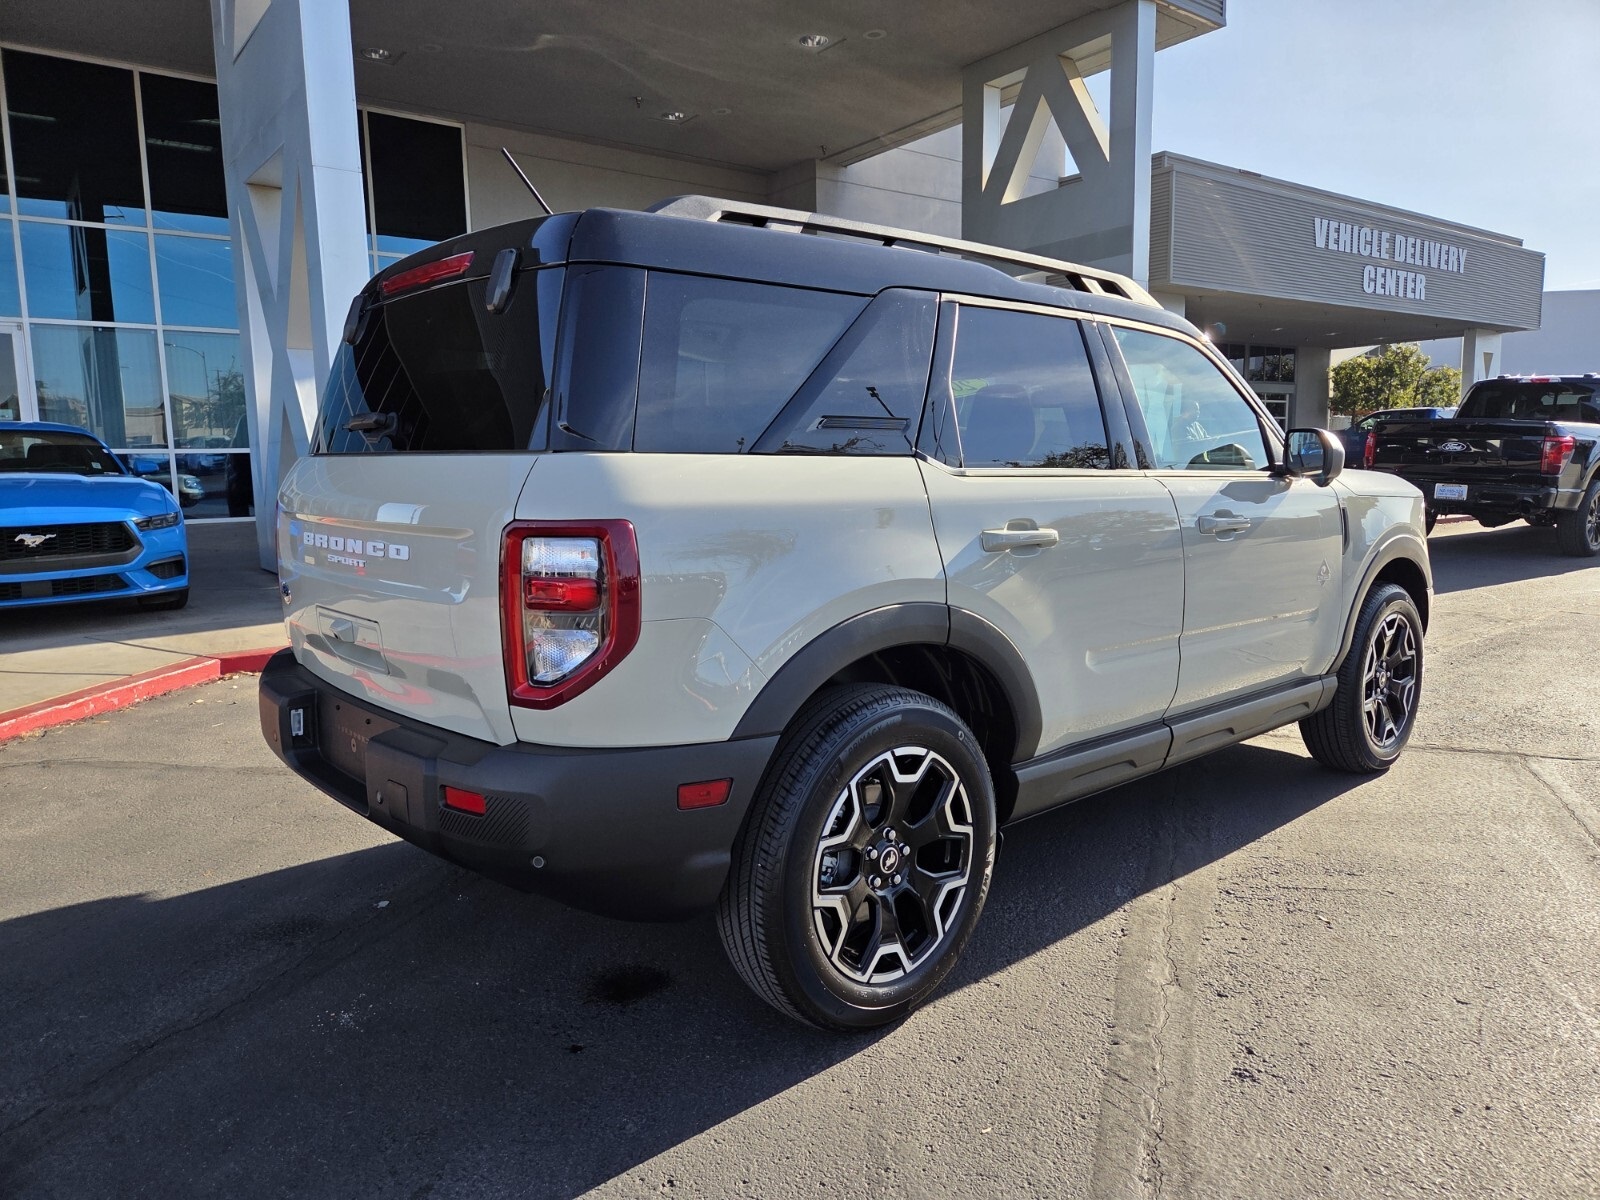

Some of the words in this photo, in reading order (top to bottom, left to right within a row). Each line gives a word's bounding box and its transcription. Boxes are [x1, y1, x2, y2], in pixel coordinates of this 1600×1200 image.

[1315, 218, 1389, 260] VEHICLE
[1395, 235, 1467, 273] DELIVERY
[1363, 265, 1425, 300] CENTER
[1444, 442, 1464, 451] Ford
[303, 531, 409, 560] BRONCO
[327, 553, 367, 568] SPORT
